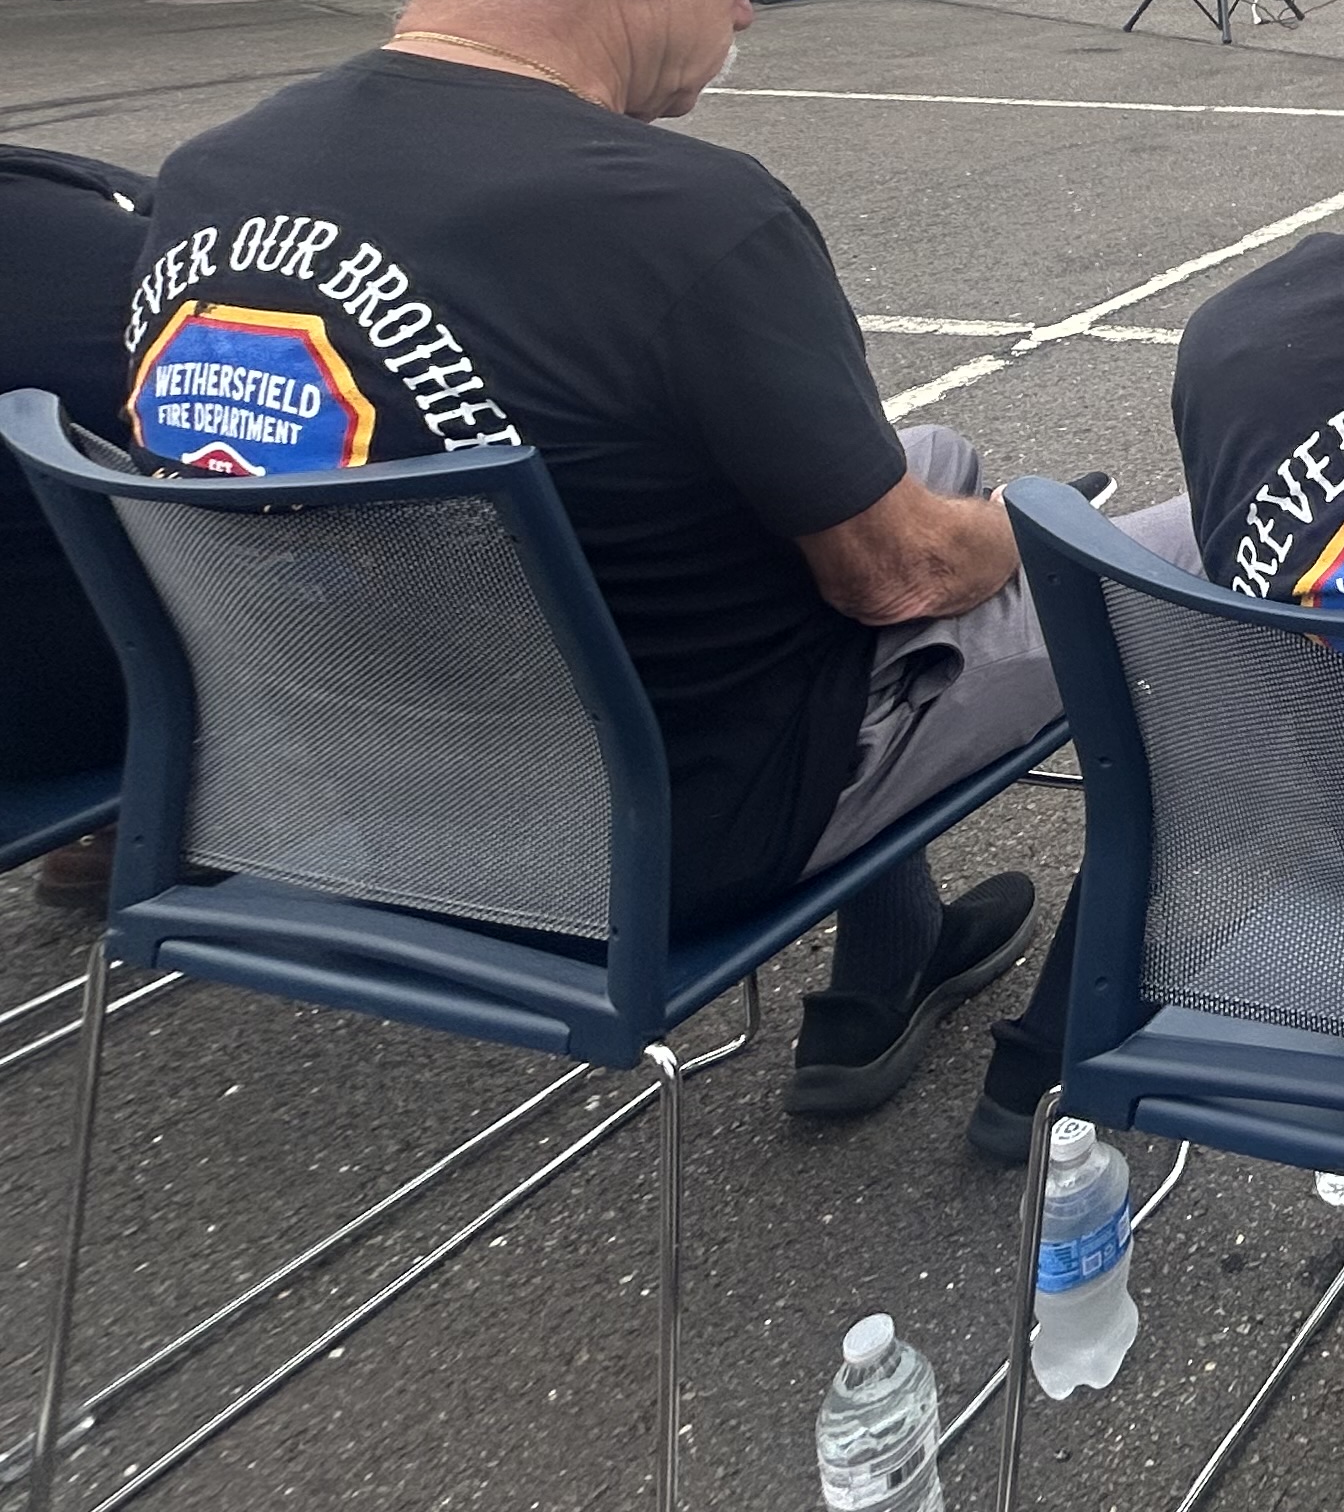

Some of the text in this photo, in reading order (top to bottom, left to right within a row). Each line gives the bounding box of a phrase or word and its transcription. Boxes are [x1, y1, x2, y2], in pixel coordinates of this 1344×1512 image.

[229, 215, 339, 280] OUR
[155, 362, 321, 419] WETHERSFIELD
[157, 402, 303, 445] FIRE DEPARTMENT
